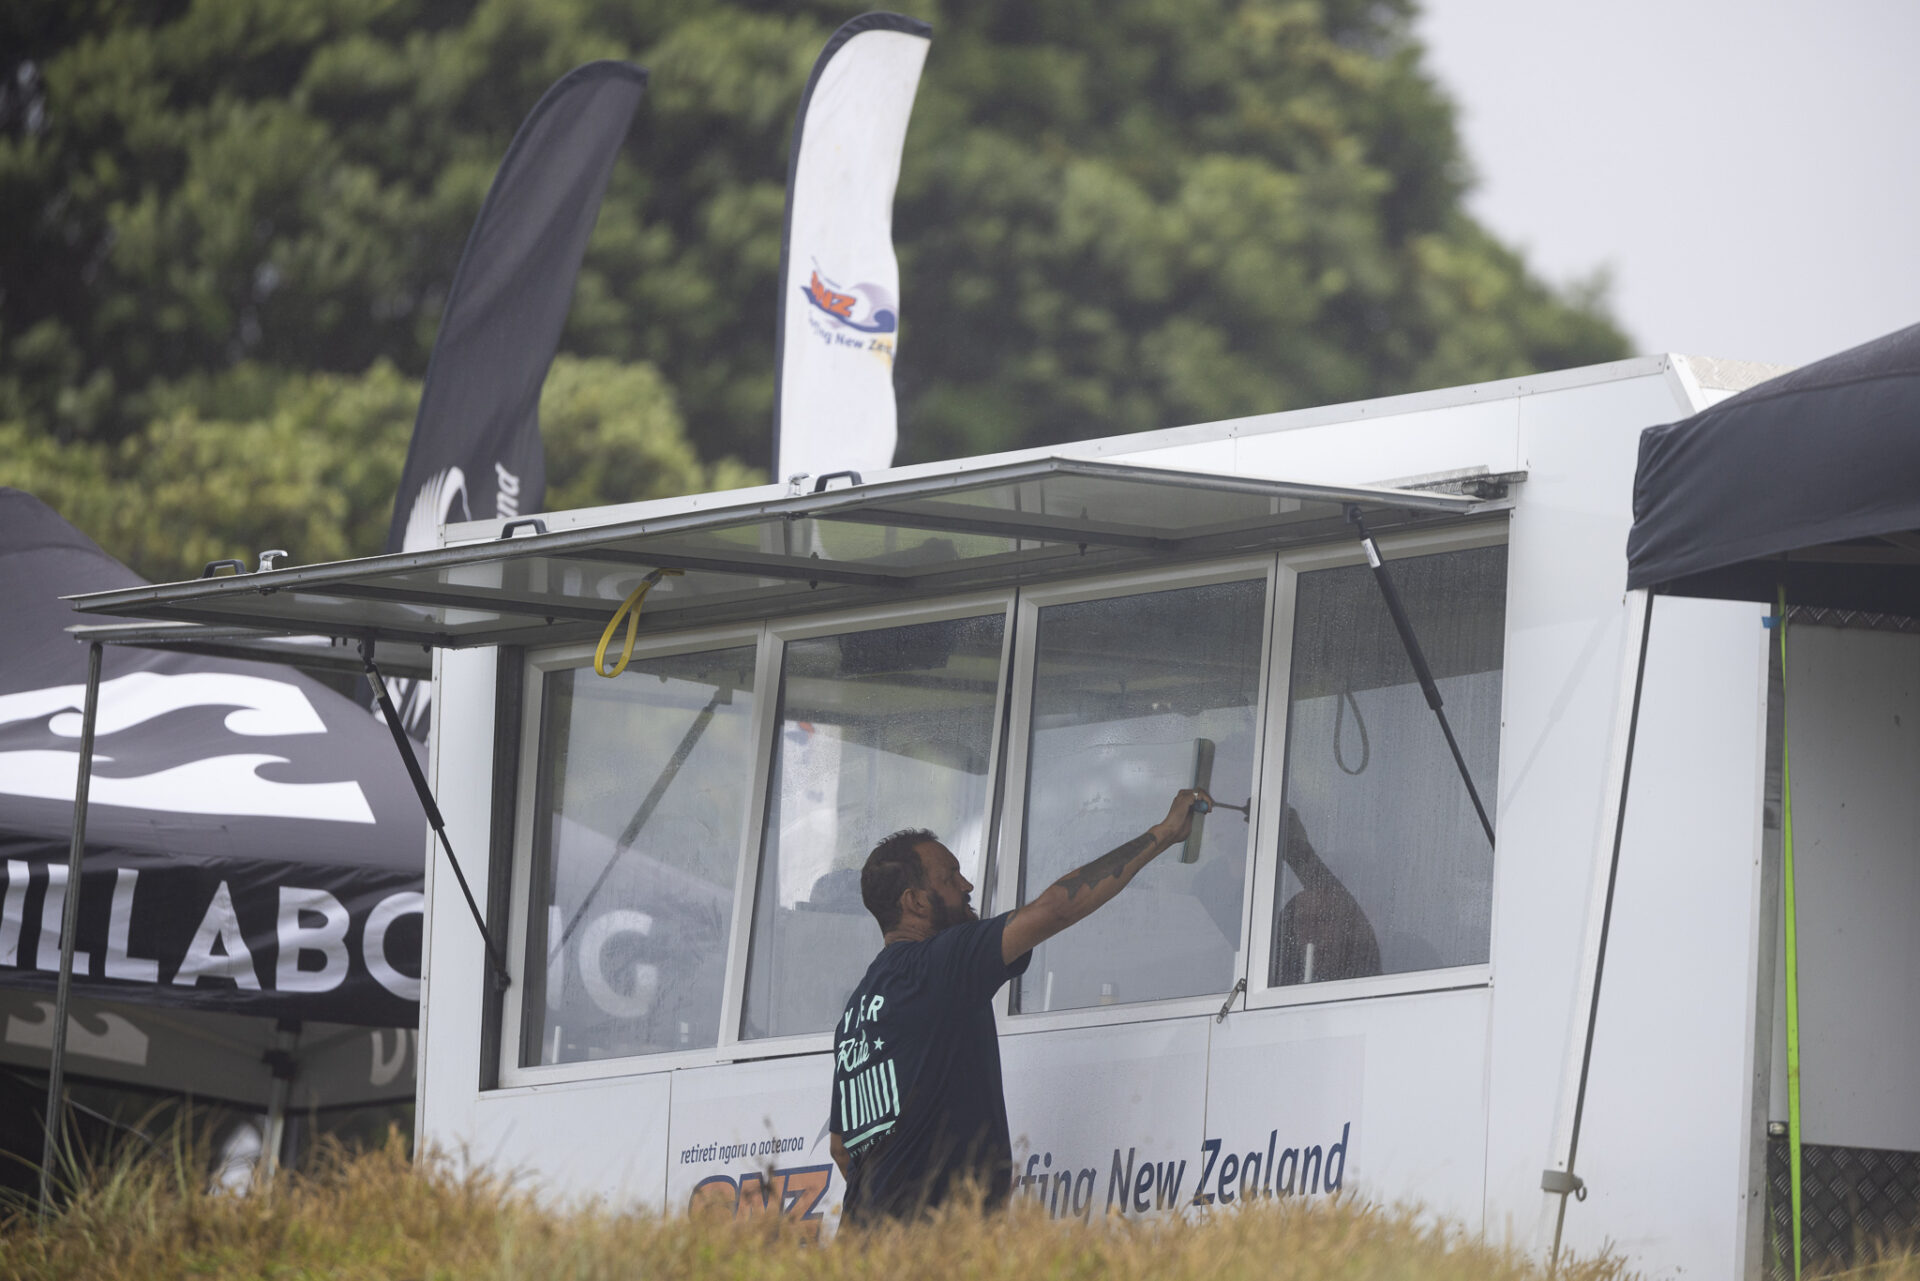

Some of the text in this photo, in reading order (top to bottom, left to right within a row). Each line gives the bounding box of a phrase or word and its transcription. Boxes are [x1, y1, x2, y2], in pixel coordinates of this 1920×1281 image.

[680, 1136, 804, 1164] retireti ngaru o aotearoa
[1013, 1121, 1350, 1226] fing New Zealand
